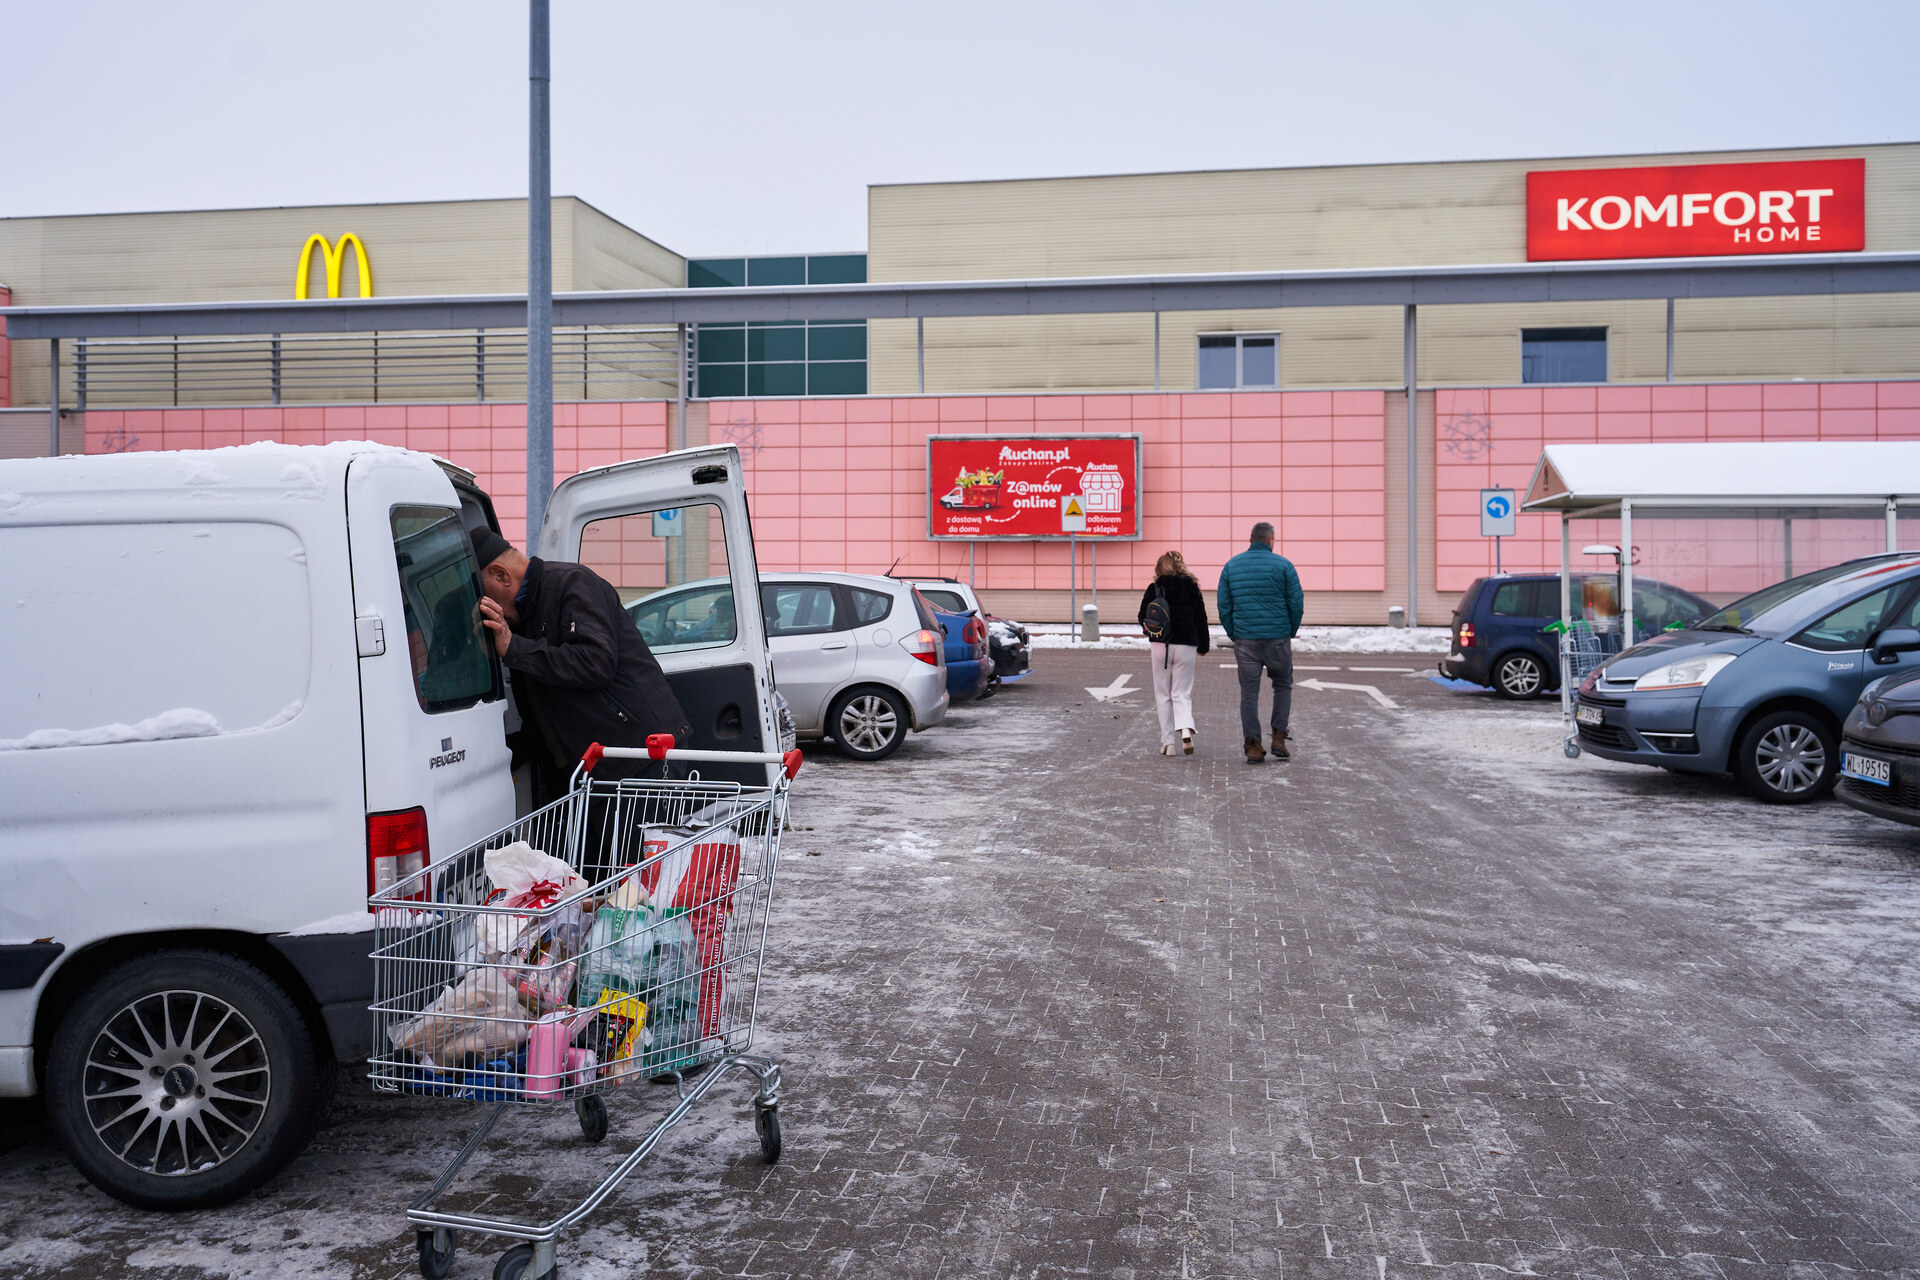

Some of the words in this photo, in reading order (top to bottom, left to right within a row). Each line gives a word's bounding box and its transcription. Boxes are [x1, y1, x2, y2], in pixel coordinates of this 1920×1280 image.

[1557, 188, 1834, 231] KOMFORT
[1734, 225, 1821, 243] HOME
[999, 446, 1070, 463] Auchan.pl
[1086, 462, 1118, 471] Auchan
[1007, 480, 1062, 495] Z@mów
[1013, 495, 1057, 508] online
[951, 515, 982, 525] dostawą
[1087, 515, 1122, 523] odbiorem
[948, 525, 958, 533] do
[959, 525, 980, 533] domu
[1092, 525, 1118, 534] sklepie
[429, 750, 466, 769] PEUGEOT
[1846, 754, 1856, 773] WL
[1861, 758, 1889, 780] 1951S
